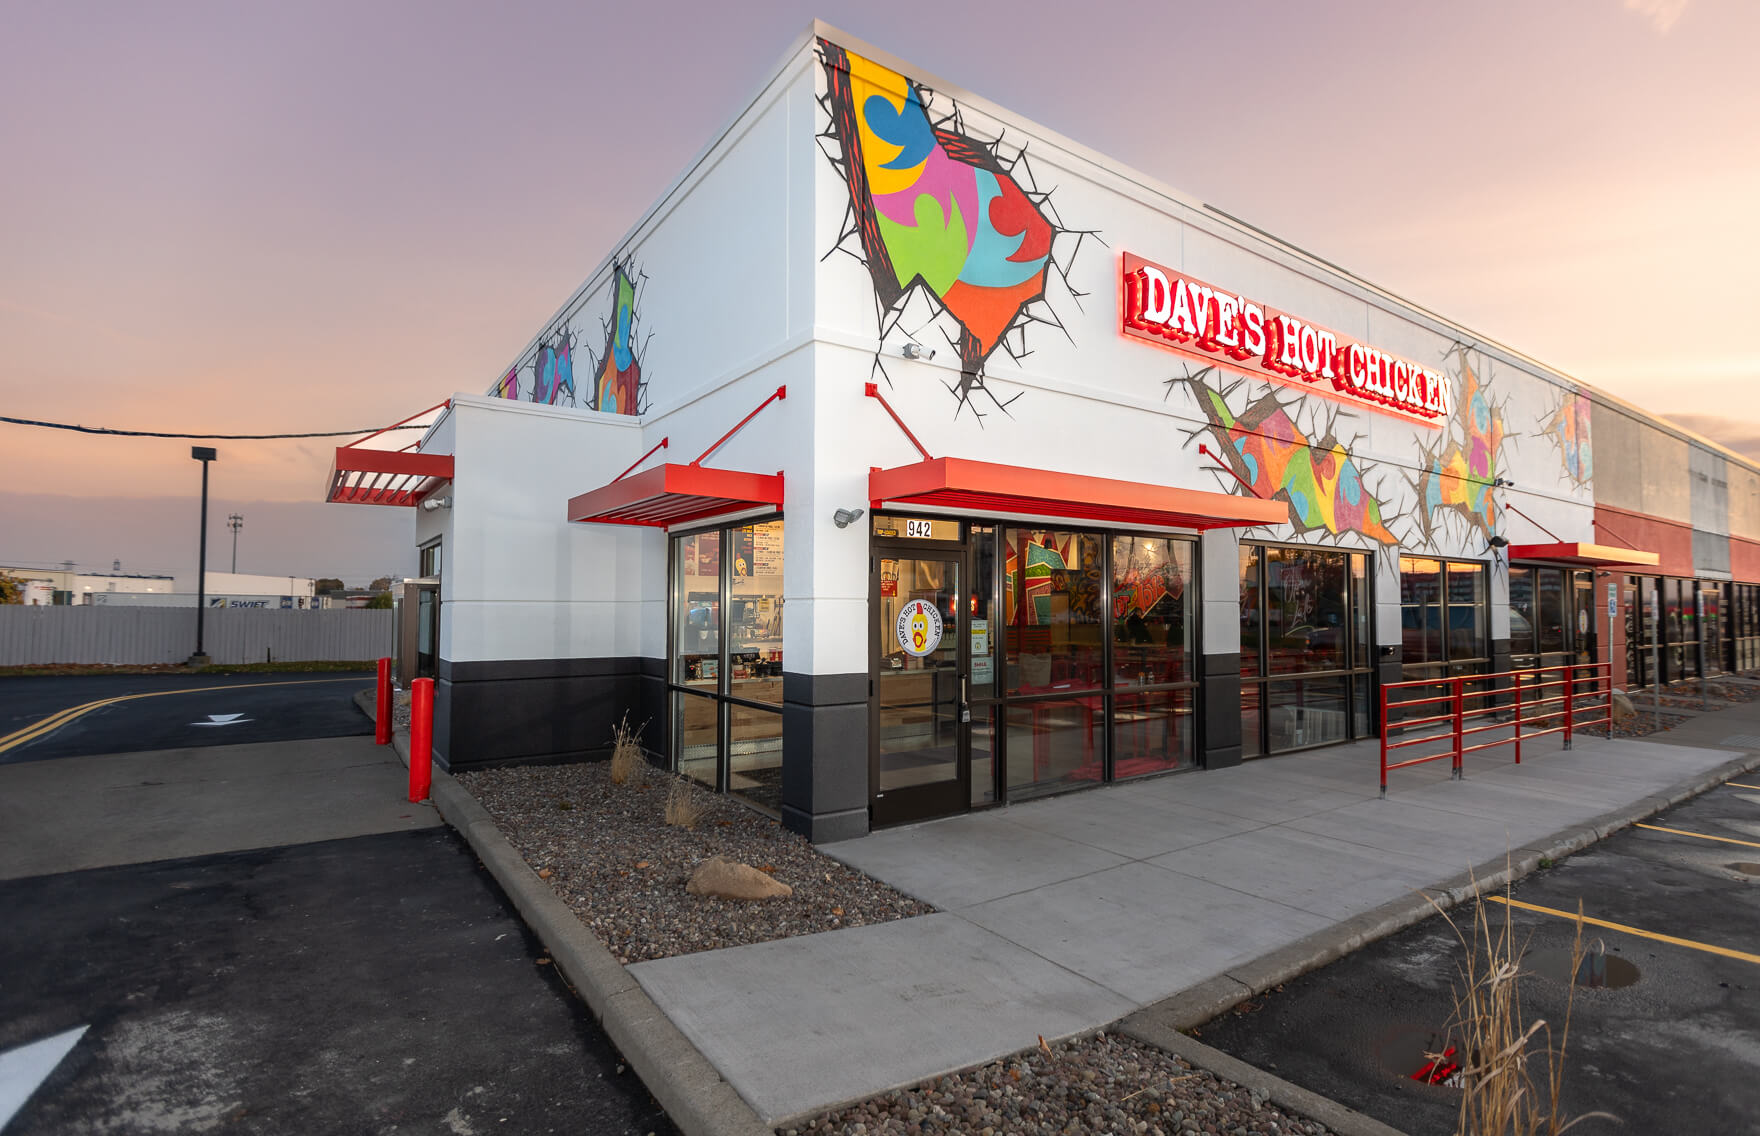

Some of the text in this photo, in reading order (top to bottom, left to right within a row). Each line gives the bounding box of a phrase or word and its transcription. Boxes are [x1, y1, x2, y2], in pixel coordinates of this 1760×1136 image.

[1139, 265, 1452, 416] DAVE'S HOT CHICKEN
[908, 520, 931, 537] 942
[231, 600, 268, 609] SWIFT
[903, 603, 917, 618] HOT
[899, 616, 909, 646] DAVE'S
[922, 603, 941, 637] CHICKEN
